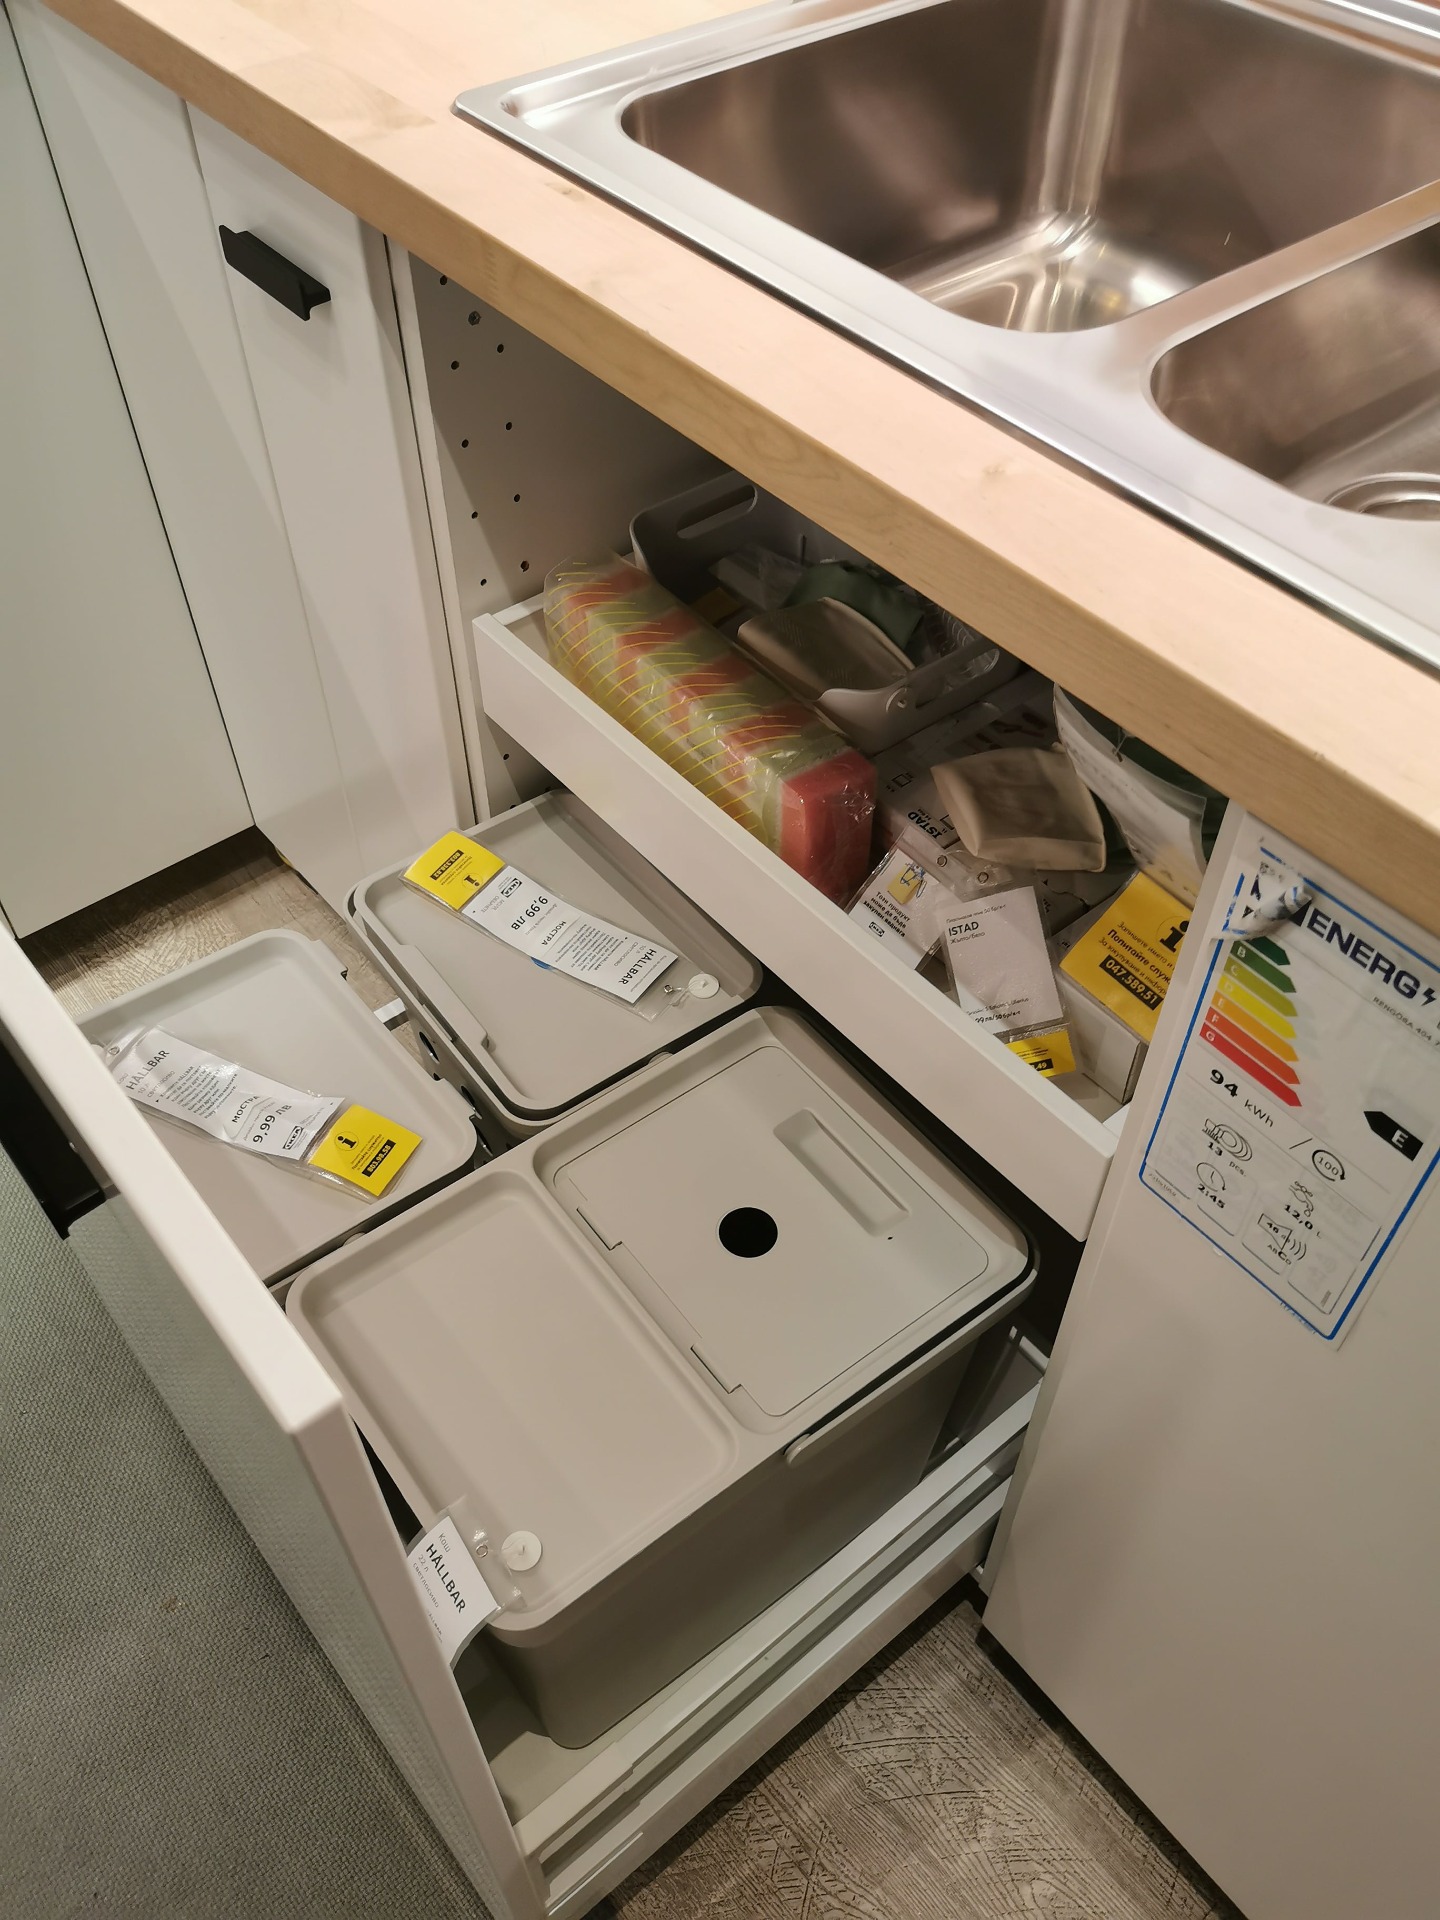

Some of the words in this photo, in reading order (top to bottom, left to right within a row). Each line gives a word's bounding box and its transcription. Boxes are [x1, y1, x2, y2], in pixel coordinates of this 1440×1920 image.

[907, 811, 942, 839] ISTAD
[522, 894, 548, 918] 9,99
[887, 902, 910, 922] продукт
[948, 922, 979, 936] ISTAD
[1098, 936, 1109, 946] За
[1106, 944, 1140, 974] закупуване
[1106, 928, 1150, 966] Попитайте
[1147, 964, 1173, 986] служ
[1147, 946, 1167, 964] името
[1237, 946, 1246, 958] B
[1307, 908, 1420, 1000] ENERG
[617, 948, 657, 986] HÅLLBAR
[1104, 958, 1158, 1004] 047.589.51
[1206, 1030, 1215, 1042] G
[124, 1049, 170, 1090] HÅLLBAR
[231, 1095, 259, 1123] МОСТРА
[1210, 1069, 1238, 1098] 94
[1244, 1099, 1274, 1128] kWh
[1208, 1142, 1224, 1156] 13
[1391, 1128, 1409, 1149] E
[1317, 1156, 1339, 1176] 100
[1198, 1184, 1226, 1208] 2:45
[1284, 1204, 1313, 1230] 12,0
[438, 1532, 450, 1552] Кош
[418, 1554, 426, 1566] 22
[426, 1544, 466, 1613] HÅLLBAR
